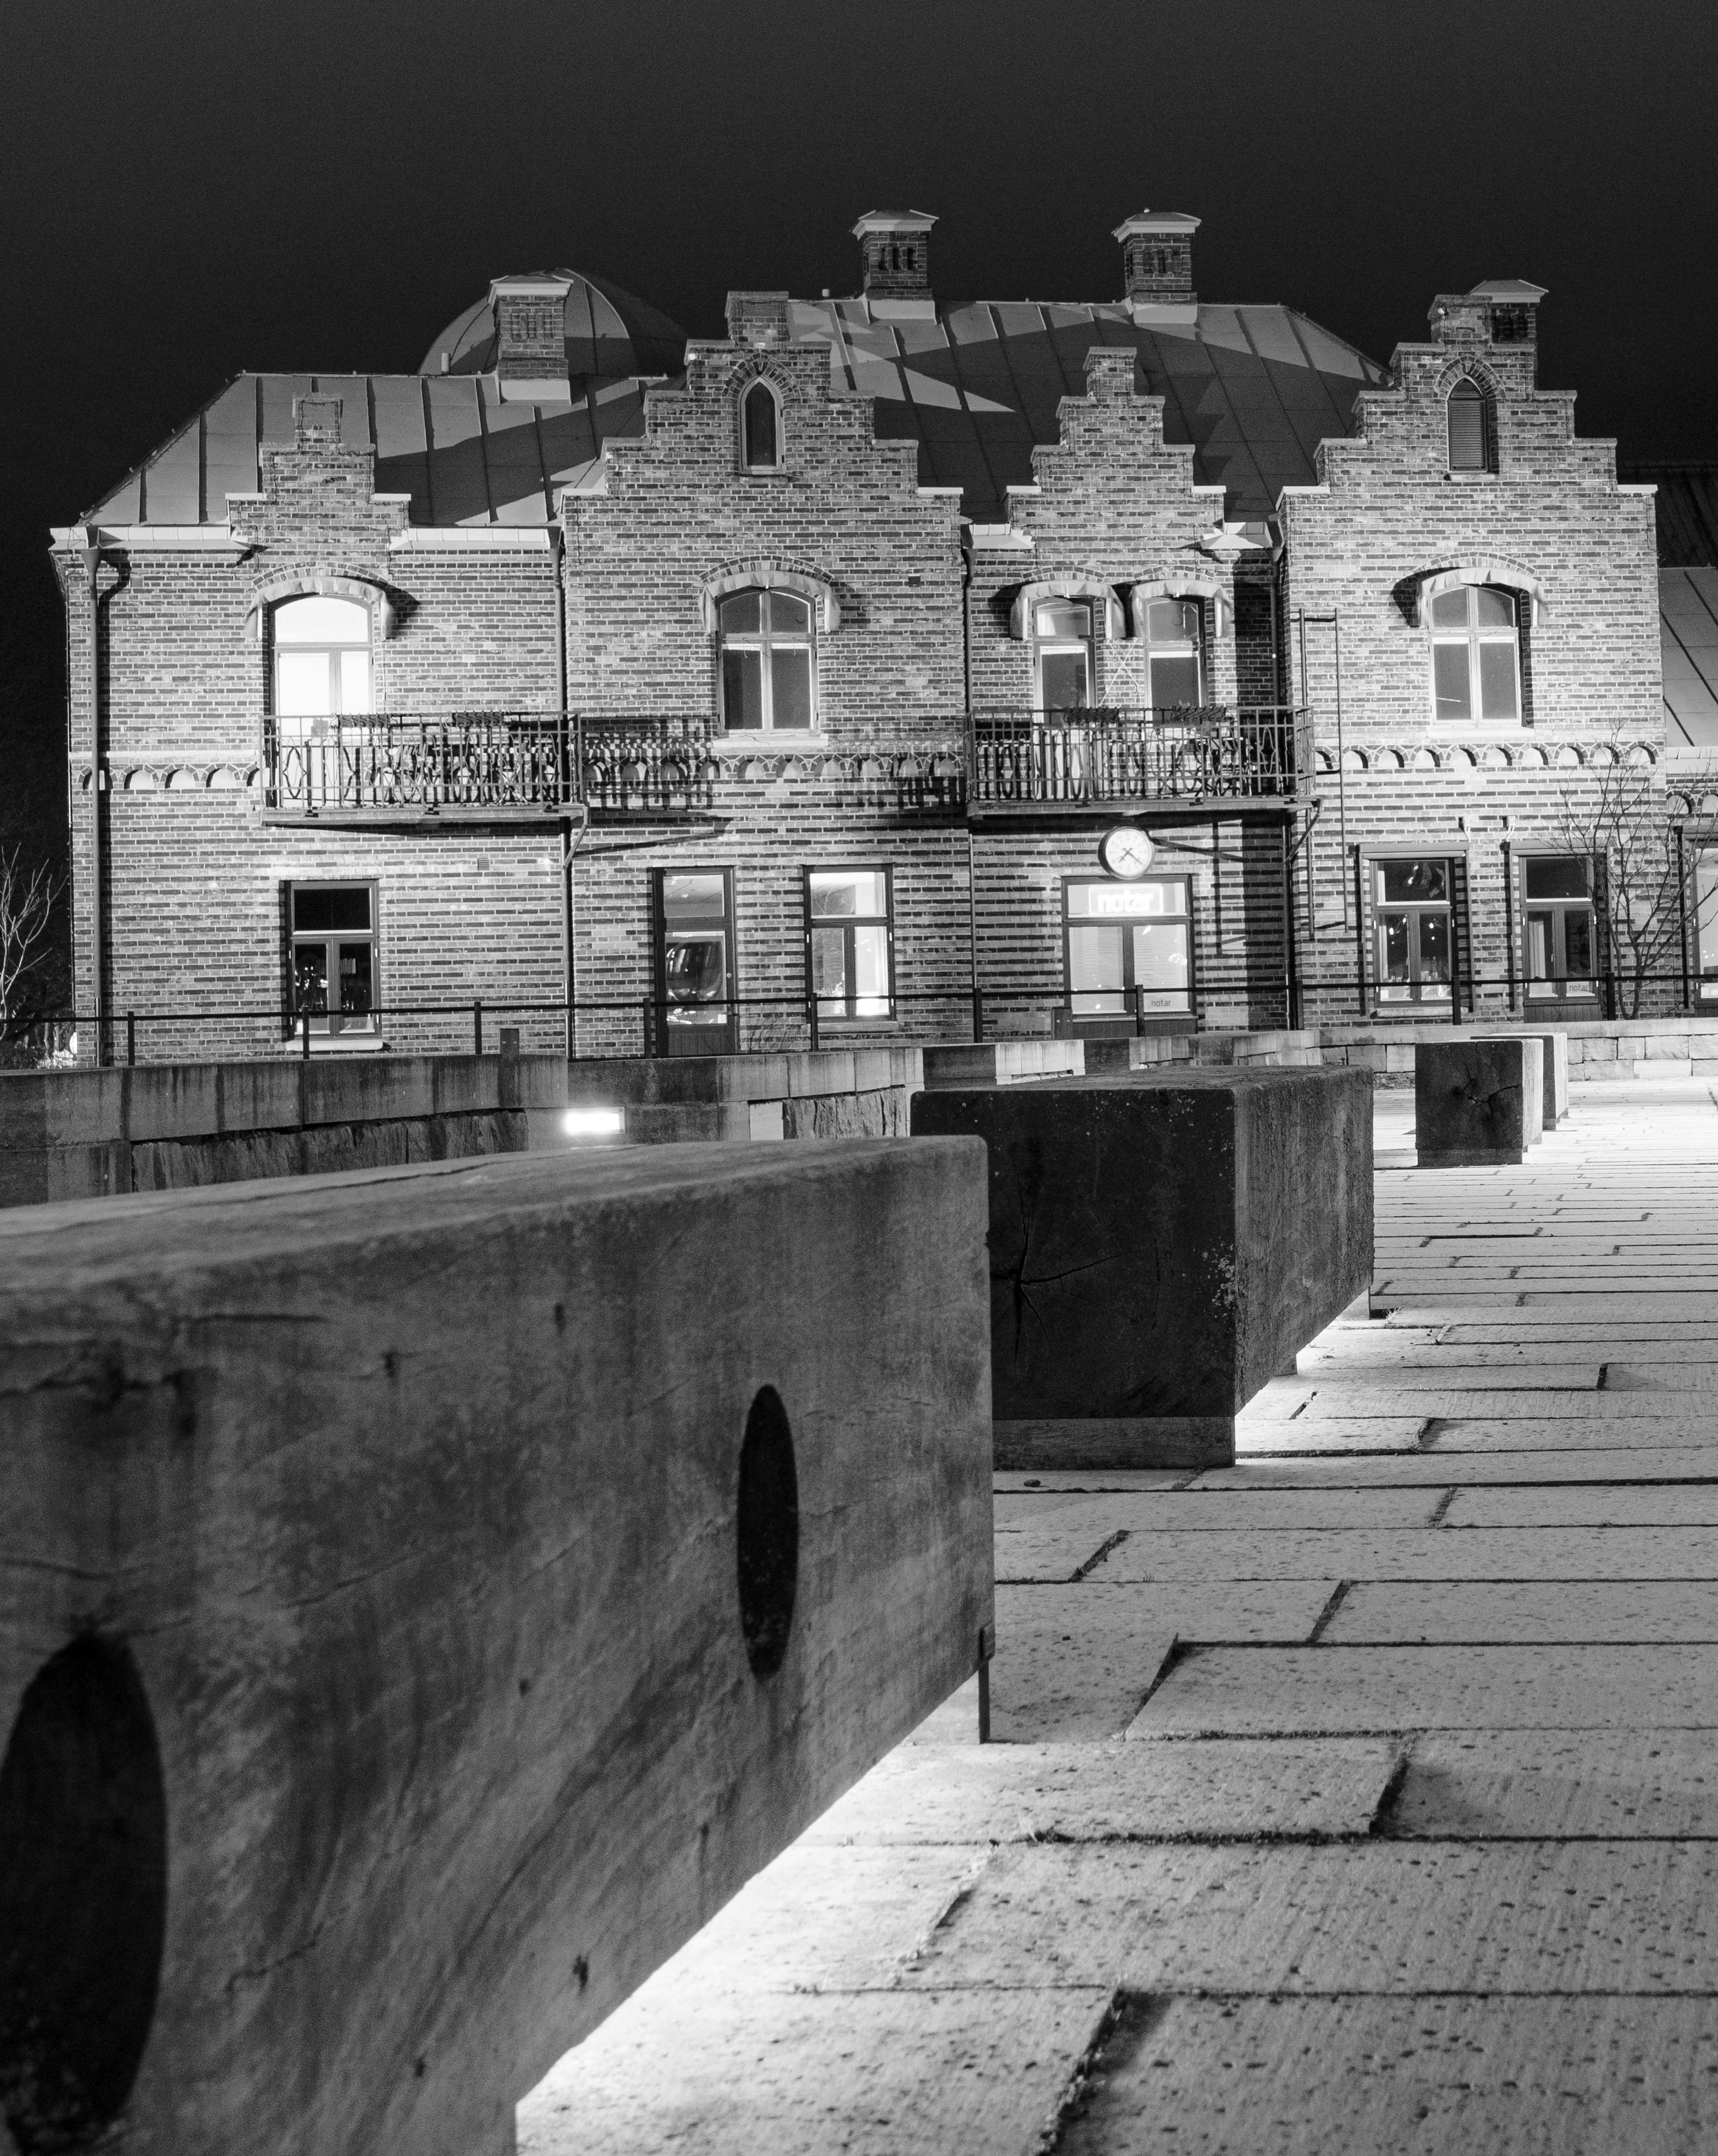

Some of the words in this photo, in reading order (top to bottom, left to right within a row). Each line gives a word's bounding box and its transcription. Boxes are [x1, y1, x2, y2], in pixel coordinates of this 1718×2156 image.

[1098, 889, 1153, 912] notar
[1569, 983, 1588, 991] notar
[1151, 999, 1171, 1007] notar
